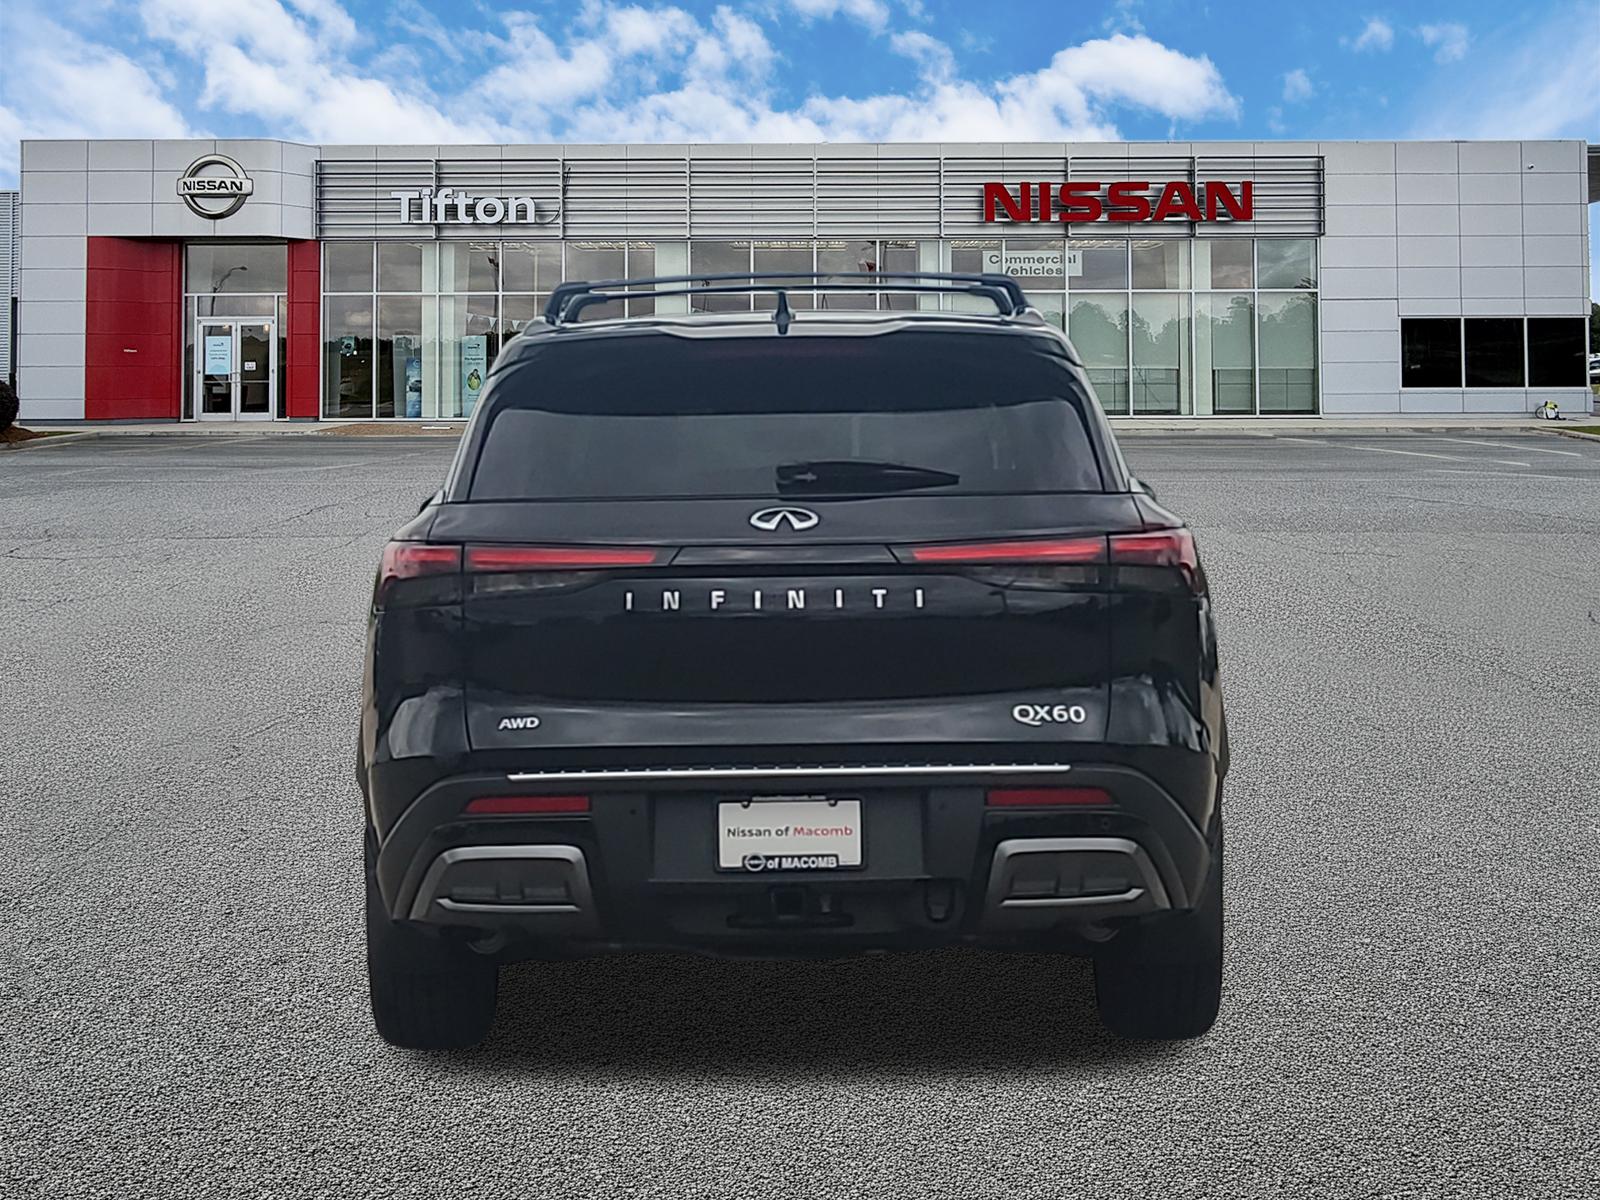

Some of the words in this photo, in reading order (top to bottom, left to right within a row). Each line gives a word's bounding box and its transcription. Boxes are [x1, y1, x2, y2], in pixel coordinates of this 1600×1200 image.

[182, 180, 243, 191] NISSAN
[391, 188, 536, 224] Tifton
[983, 181, 1254, 223] NISSAN
[625, 589, 923, 610] INFINITI
[498, 717, 540, 730] AWD
[1012, 705, 1086, 726] QX60
[727, 827, 772, 838] Nissan
[775, 826, 790, 837] of
[793, 825, 854, 837] Macomb
[766, 857, 780, 869] of
[781, 856, 837, 869] MACOMB
